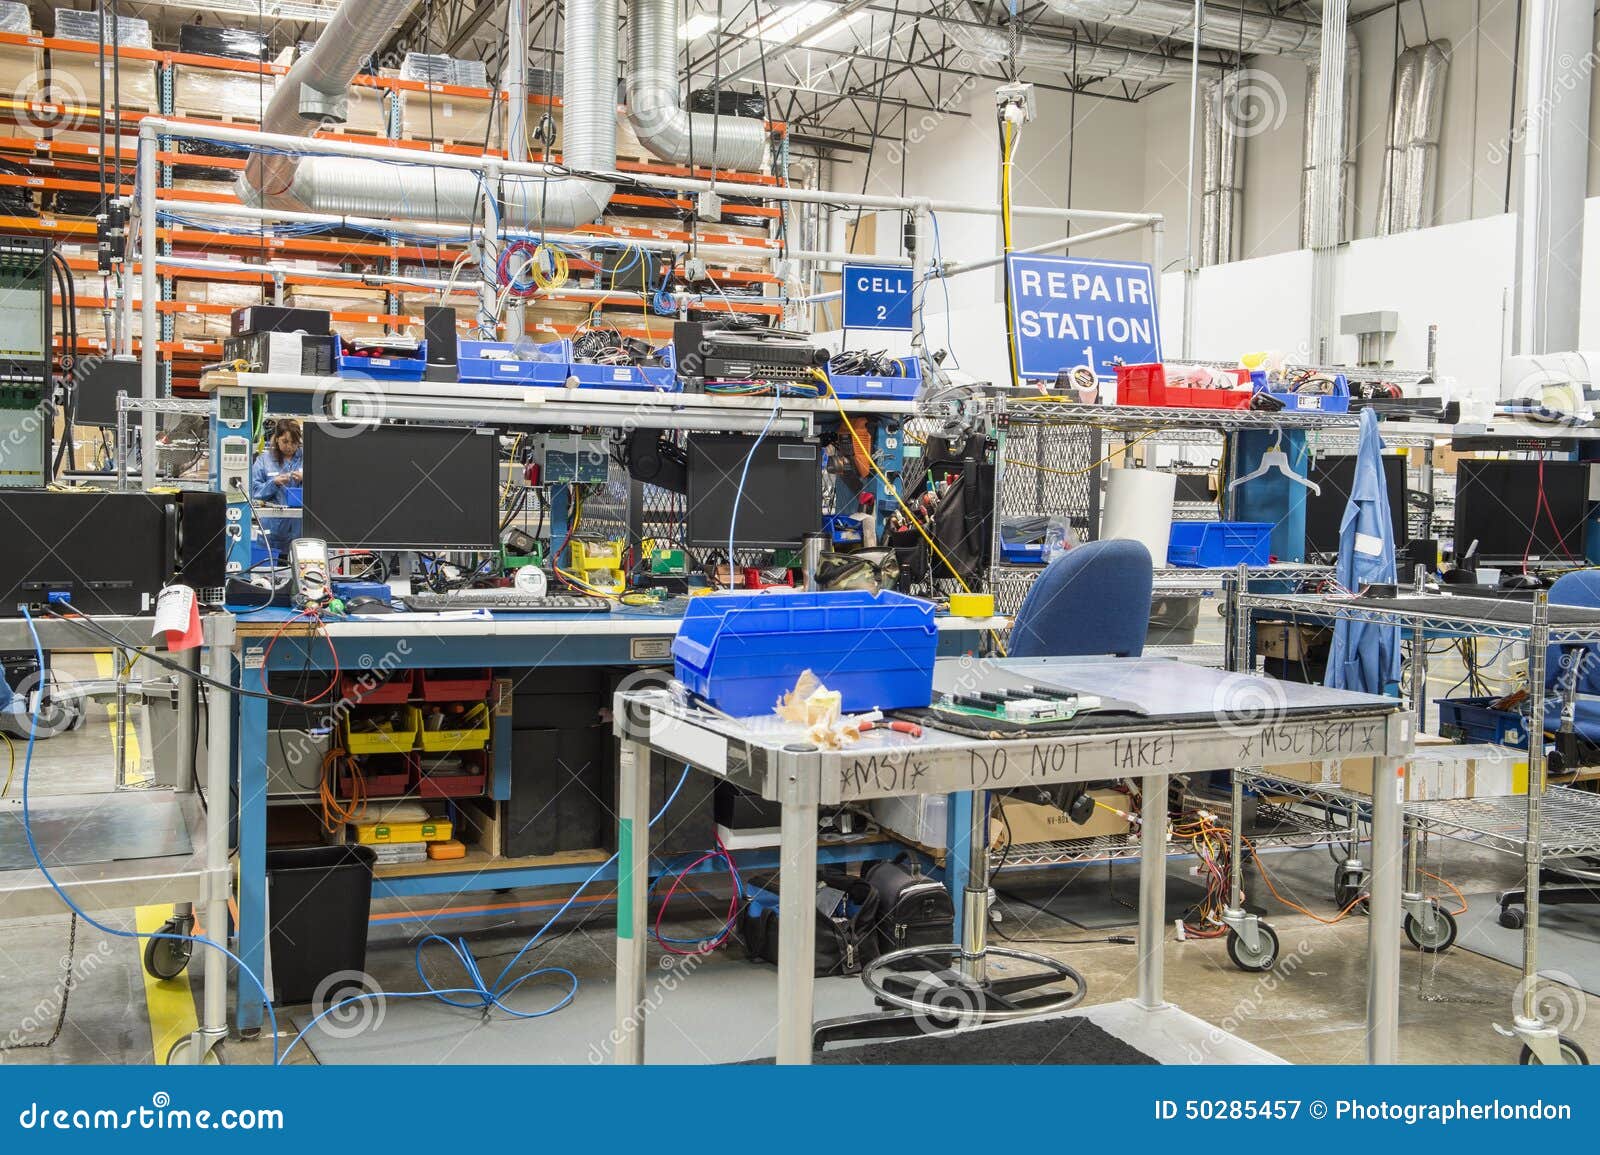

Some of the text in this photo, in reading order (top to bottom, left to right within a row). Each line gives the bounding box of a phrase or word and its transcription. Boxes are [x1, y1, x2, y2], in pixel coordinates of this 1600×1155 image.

[857, 276, 907, 294] CELL
[1021, 269, 1149, 305] REPAIR
[877, 305, 887, 320] 2
[1020, 310, 1151, 344] STATION
[1082, 346, 1094, 371] 1
[966, 735, 1175, 789] DO NOT TAKE!
